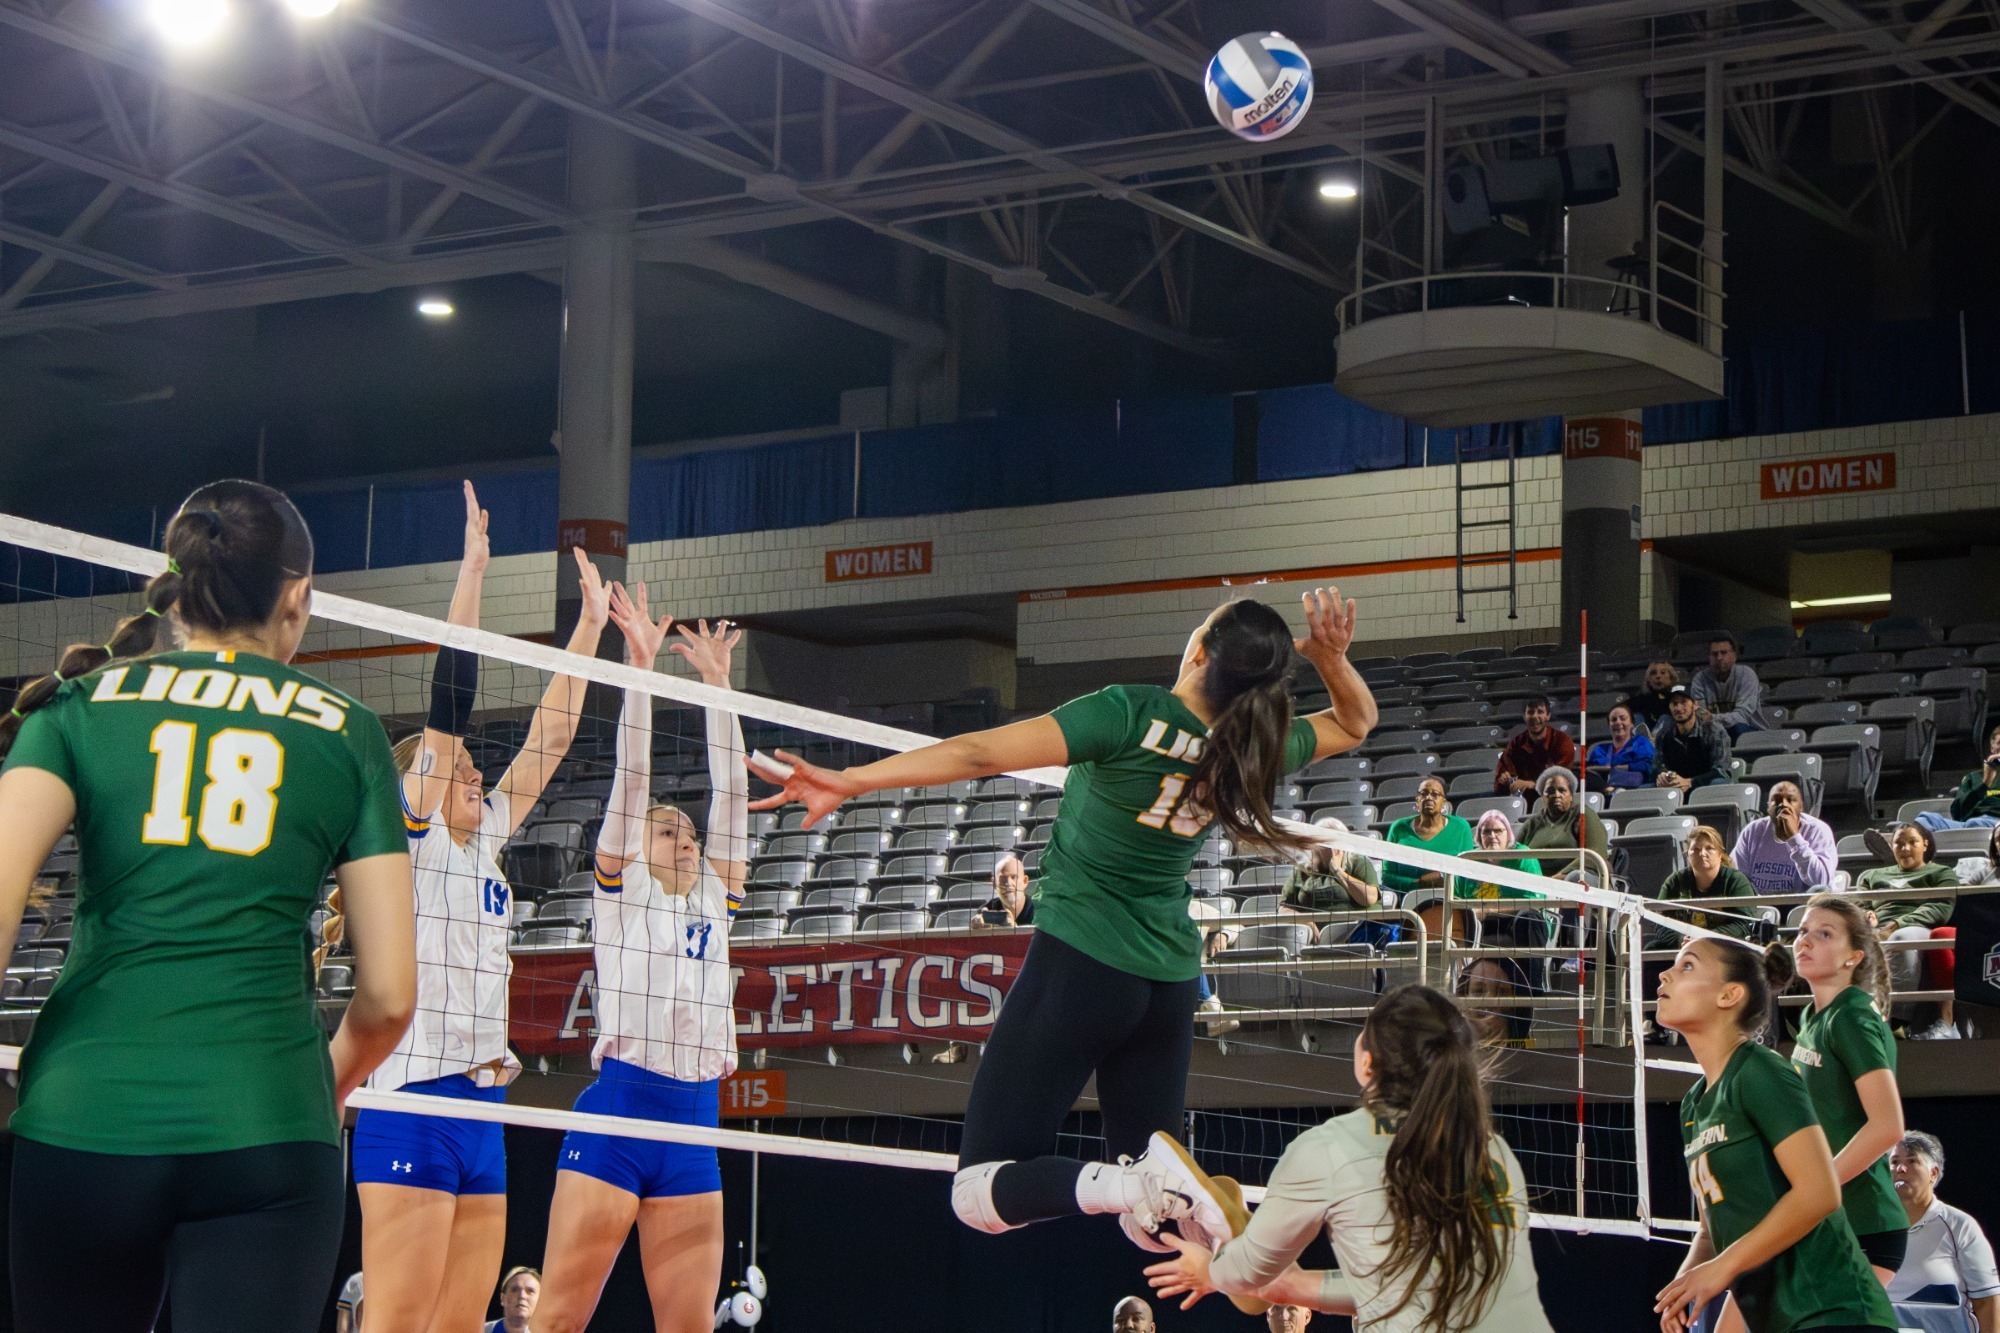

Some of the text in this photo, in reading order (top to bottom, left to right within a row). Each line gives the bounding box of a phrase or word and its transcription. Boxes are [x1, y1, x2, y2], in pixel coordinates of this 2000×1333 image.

[1244, 79, 1294, 123] molten
[1568, 427, 1600, 450] 115
[1772, 459, 1883, 493] WOMEN
[835, 547, 923, 577] WOMEN
[90, 664, 350, 732] LIONS
[141, 719, 285, 857] 18
[558, 954, 1006, 1039] ALETICS
[728, 1078, 769, 1108] 115
